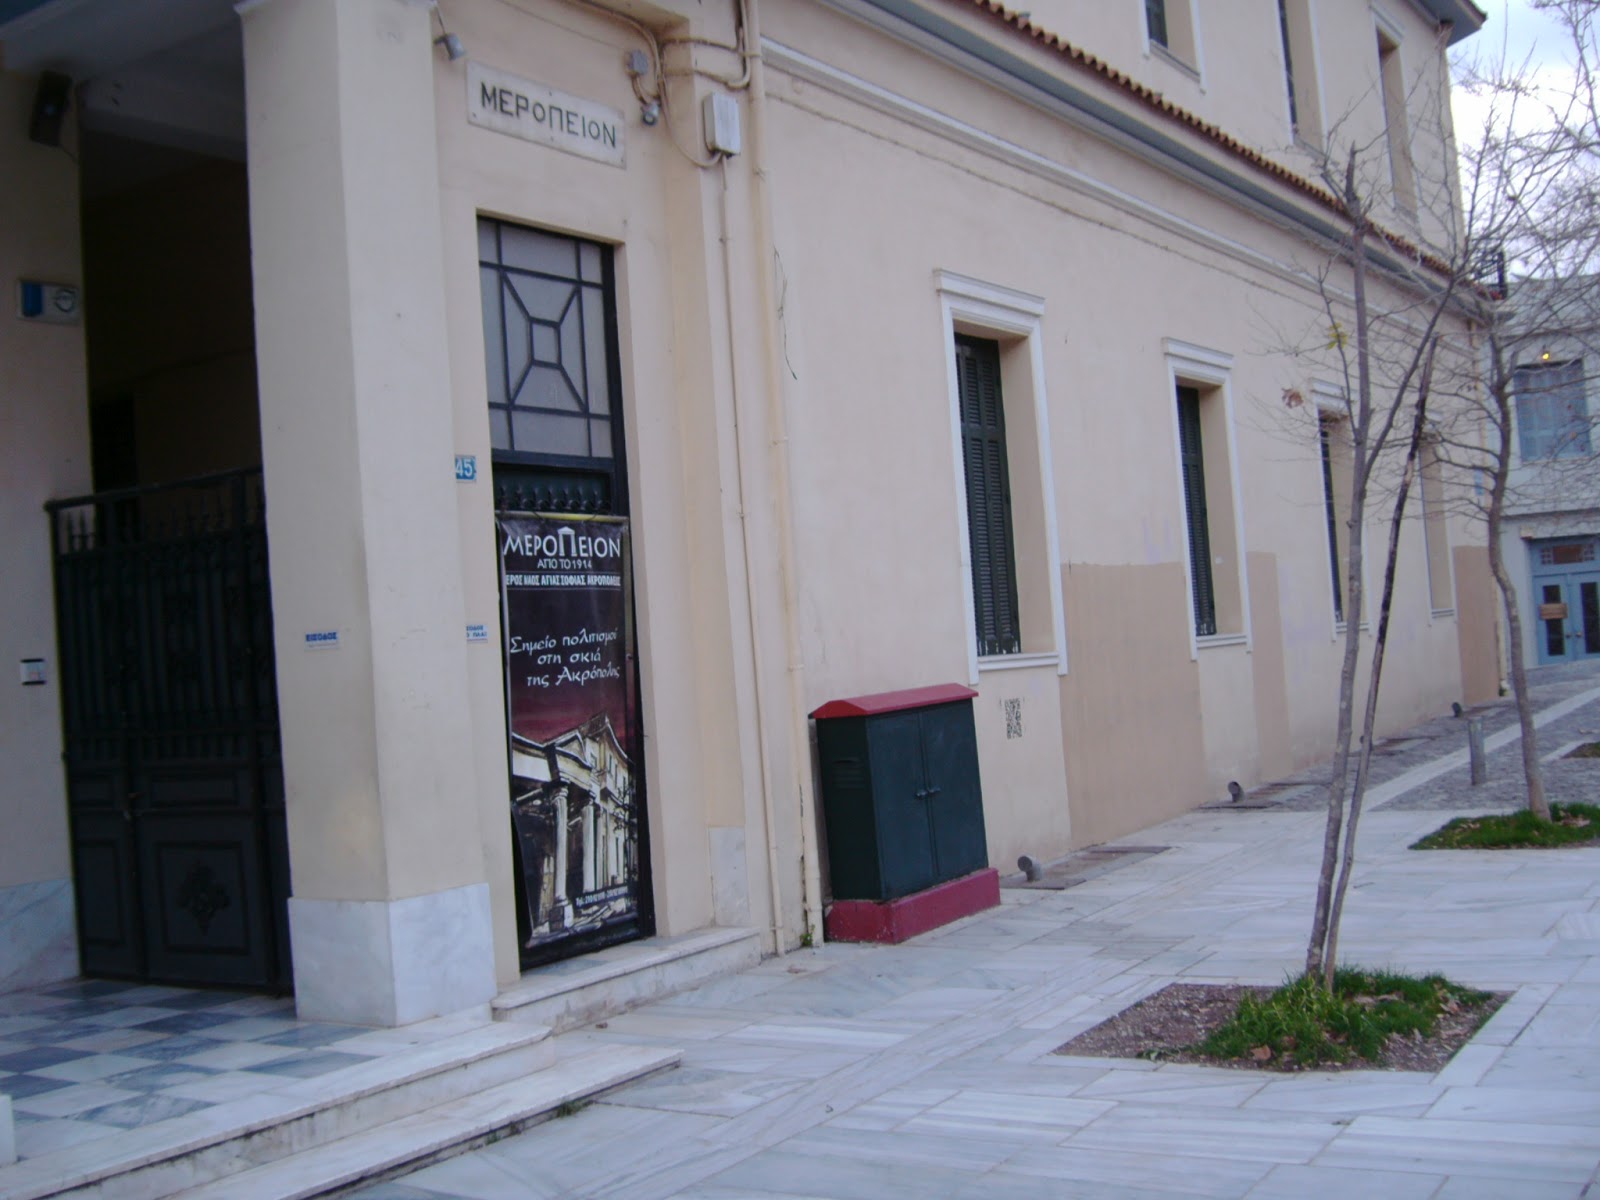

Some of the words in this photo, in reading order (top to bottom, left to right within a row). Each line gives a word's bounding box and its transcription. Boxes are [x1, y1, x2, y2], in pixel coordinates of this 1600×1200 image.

[481, 81, 616, 148] ΜΕΡΟΠΕΙΟΝ
[456, 456, 473, 478] 45
[503, 526, 621, 558] ΜΕΡΟΠΕΙΟΝ
[537, 558, 558, 570] ΑΠΟ
[559, 558, 571, 570] ΤΟ
[572, 559, 592, 570] 1914
[506, 574, 523, 586] ΕΡΟΣ
[541, 574, 561, 586] ΑΓΙΑΣ
[561, 574, 586, 586] ΣΟΦΙΑΣ
[510, 635, 557, 656] Σημείο
[537, 653, 562, 666] στη
[570, 647, 601, 663] σκιά
[527, 675, 549, 688] της
